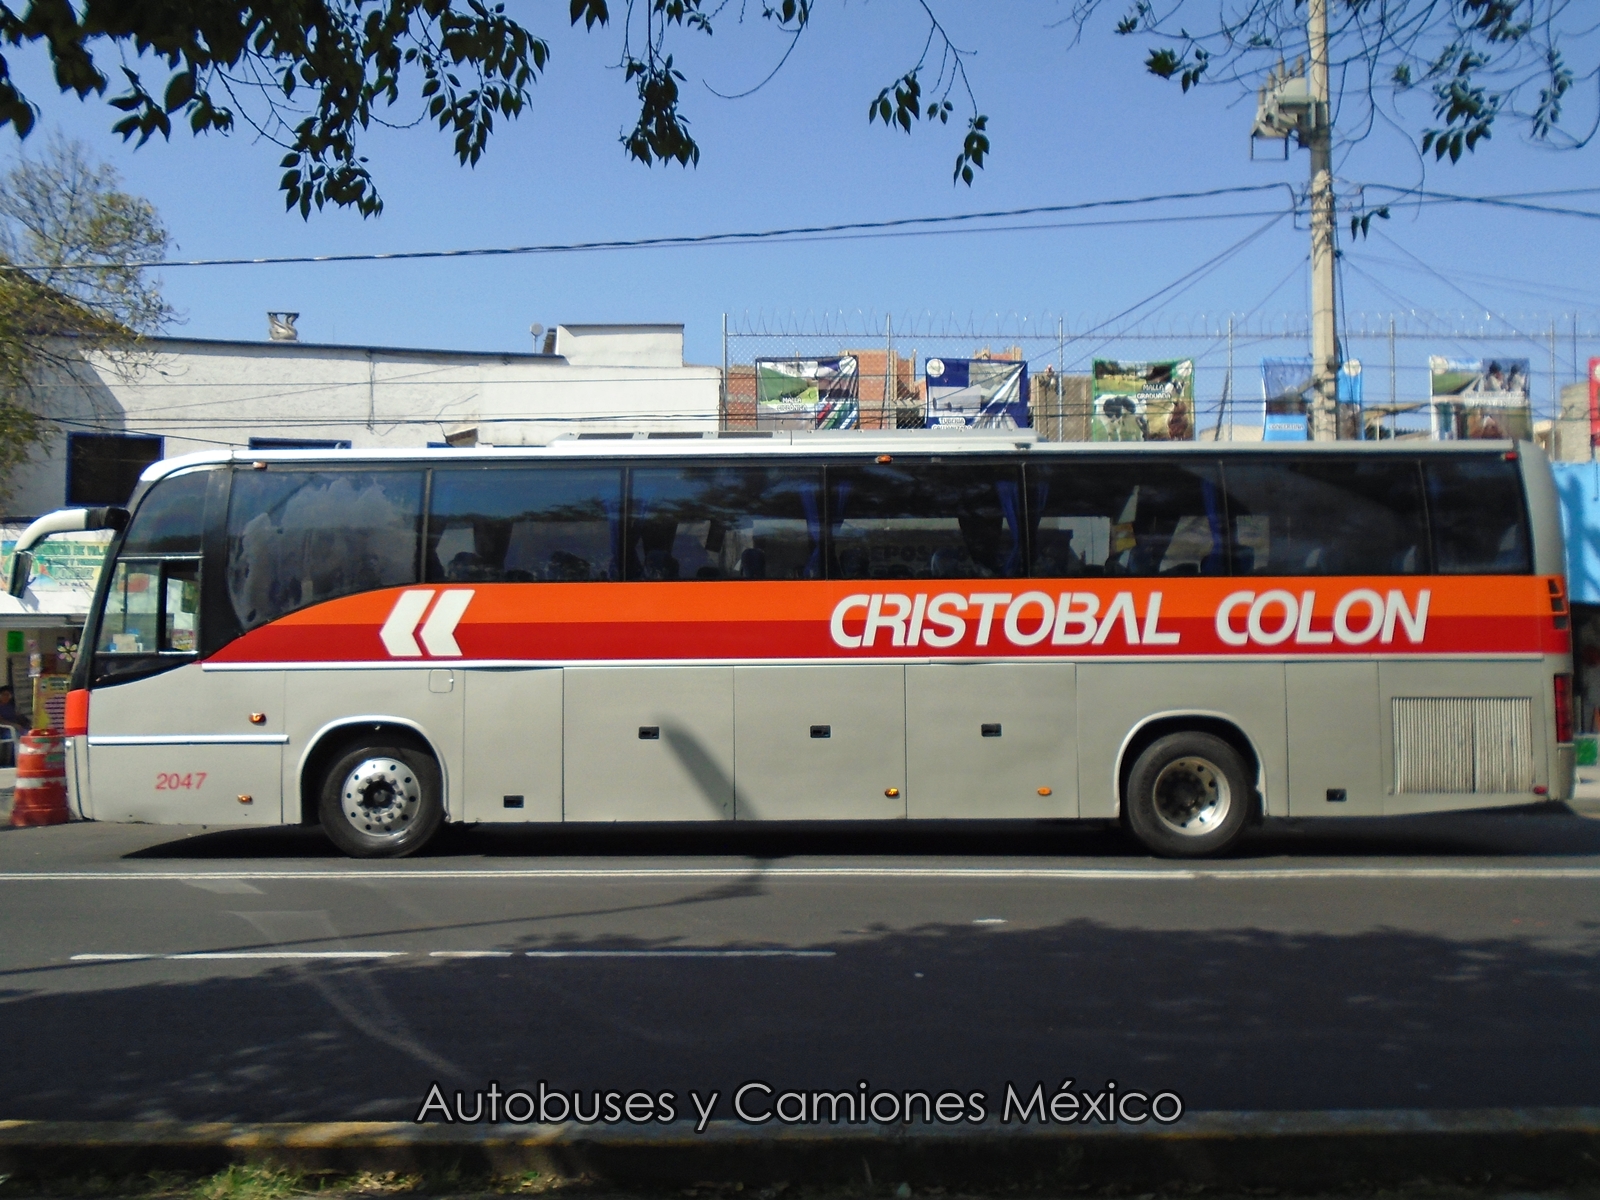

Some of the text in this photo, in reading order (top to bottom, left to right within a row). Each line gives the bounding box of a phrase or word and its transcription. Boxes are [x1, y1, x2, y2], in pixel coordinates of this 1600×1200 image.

[830, 588, 1431, 648] CRISTOBAL COLON
[155, 772, 207, 790] 2047
